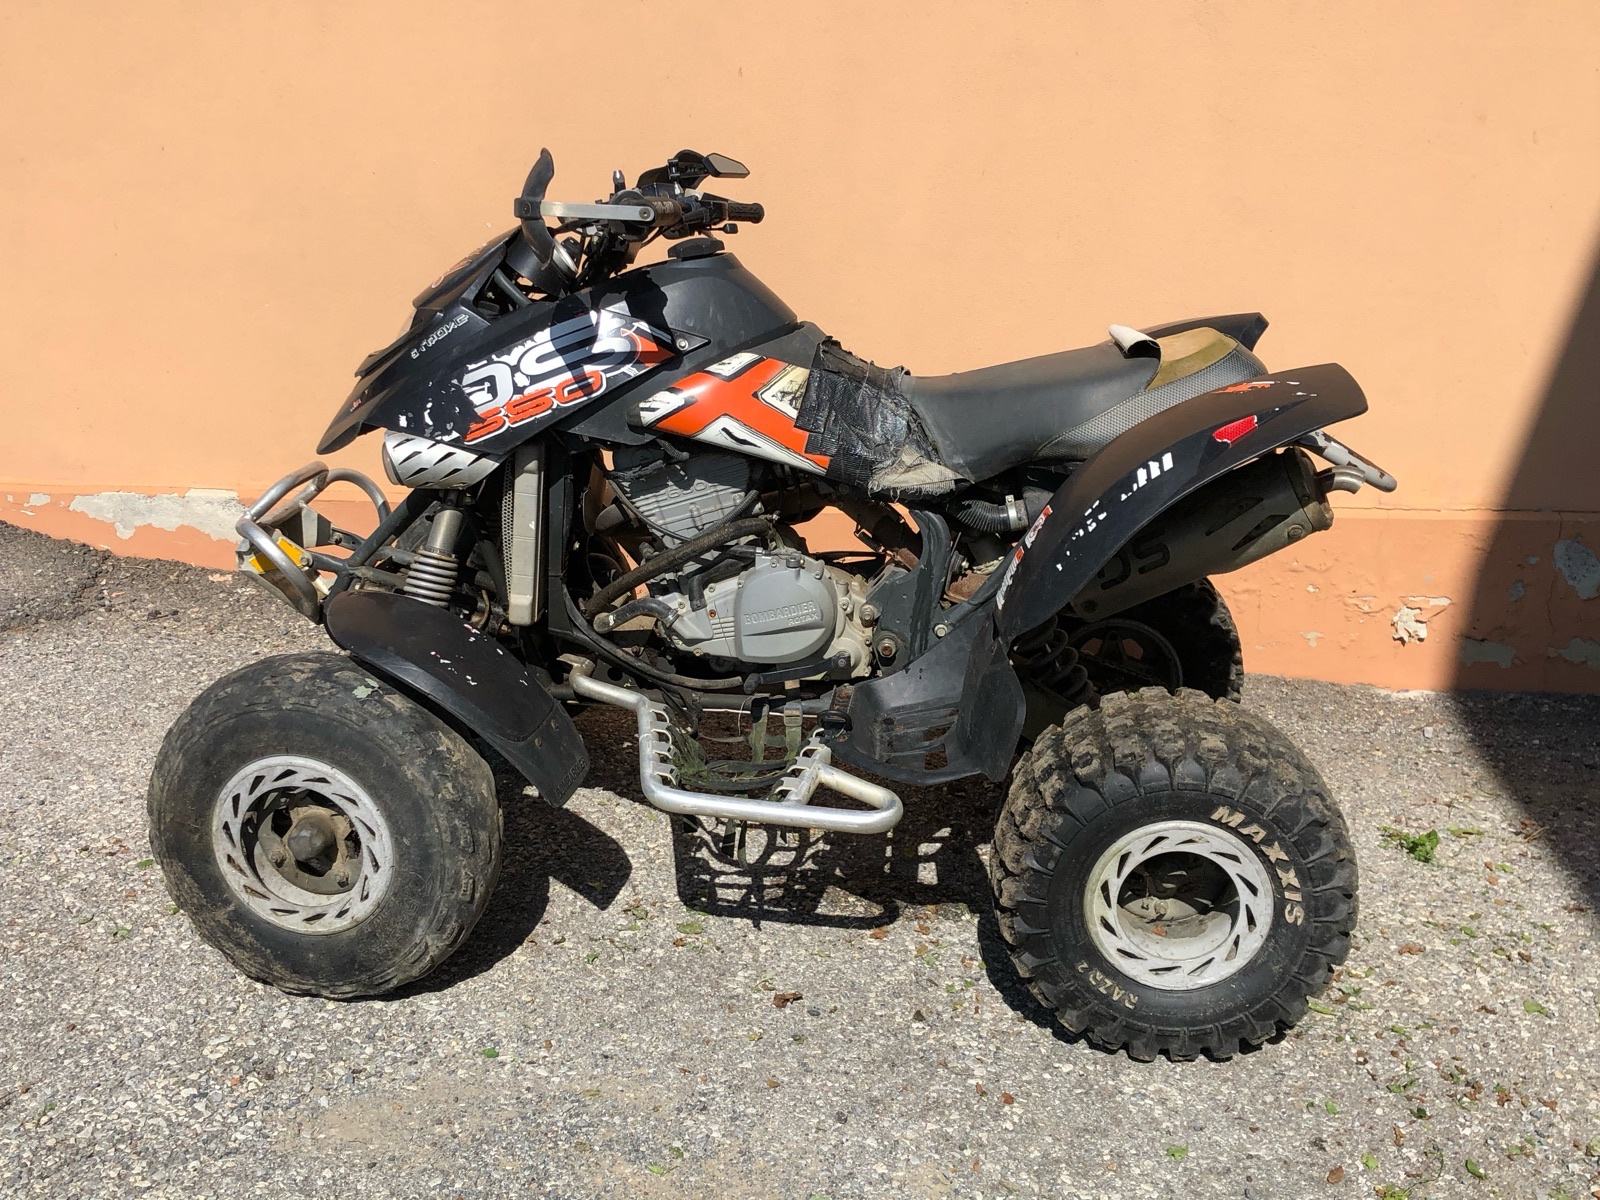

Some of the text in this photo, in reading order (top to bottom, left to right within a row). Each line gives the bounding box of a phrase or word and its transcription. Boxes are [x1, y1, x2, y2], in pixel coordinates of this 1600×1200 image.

[743, 600, 817, 625] BOMBARDIER
[787, 613, 819, 626] ROTAX
[1210, 804, 1305, 927] MAXXIS
